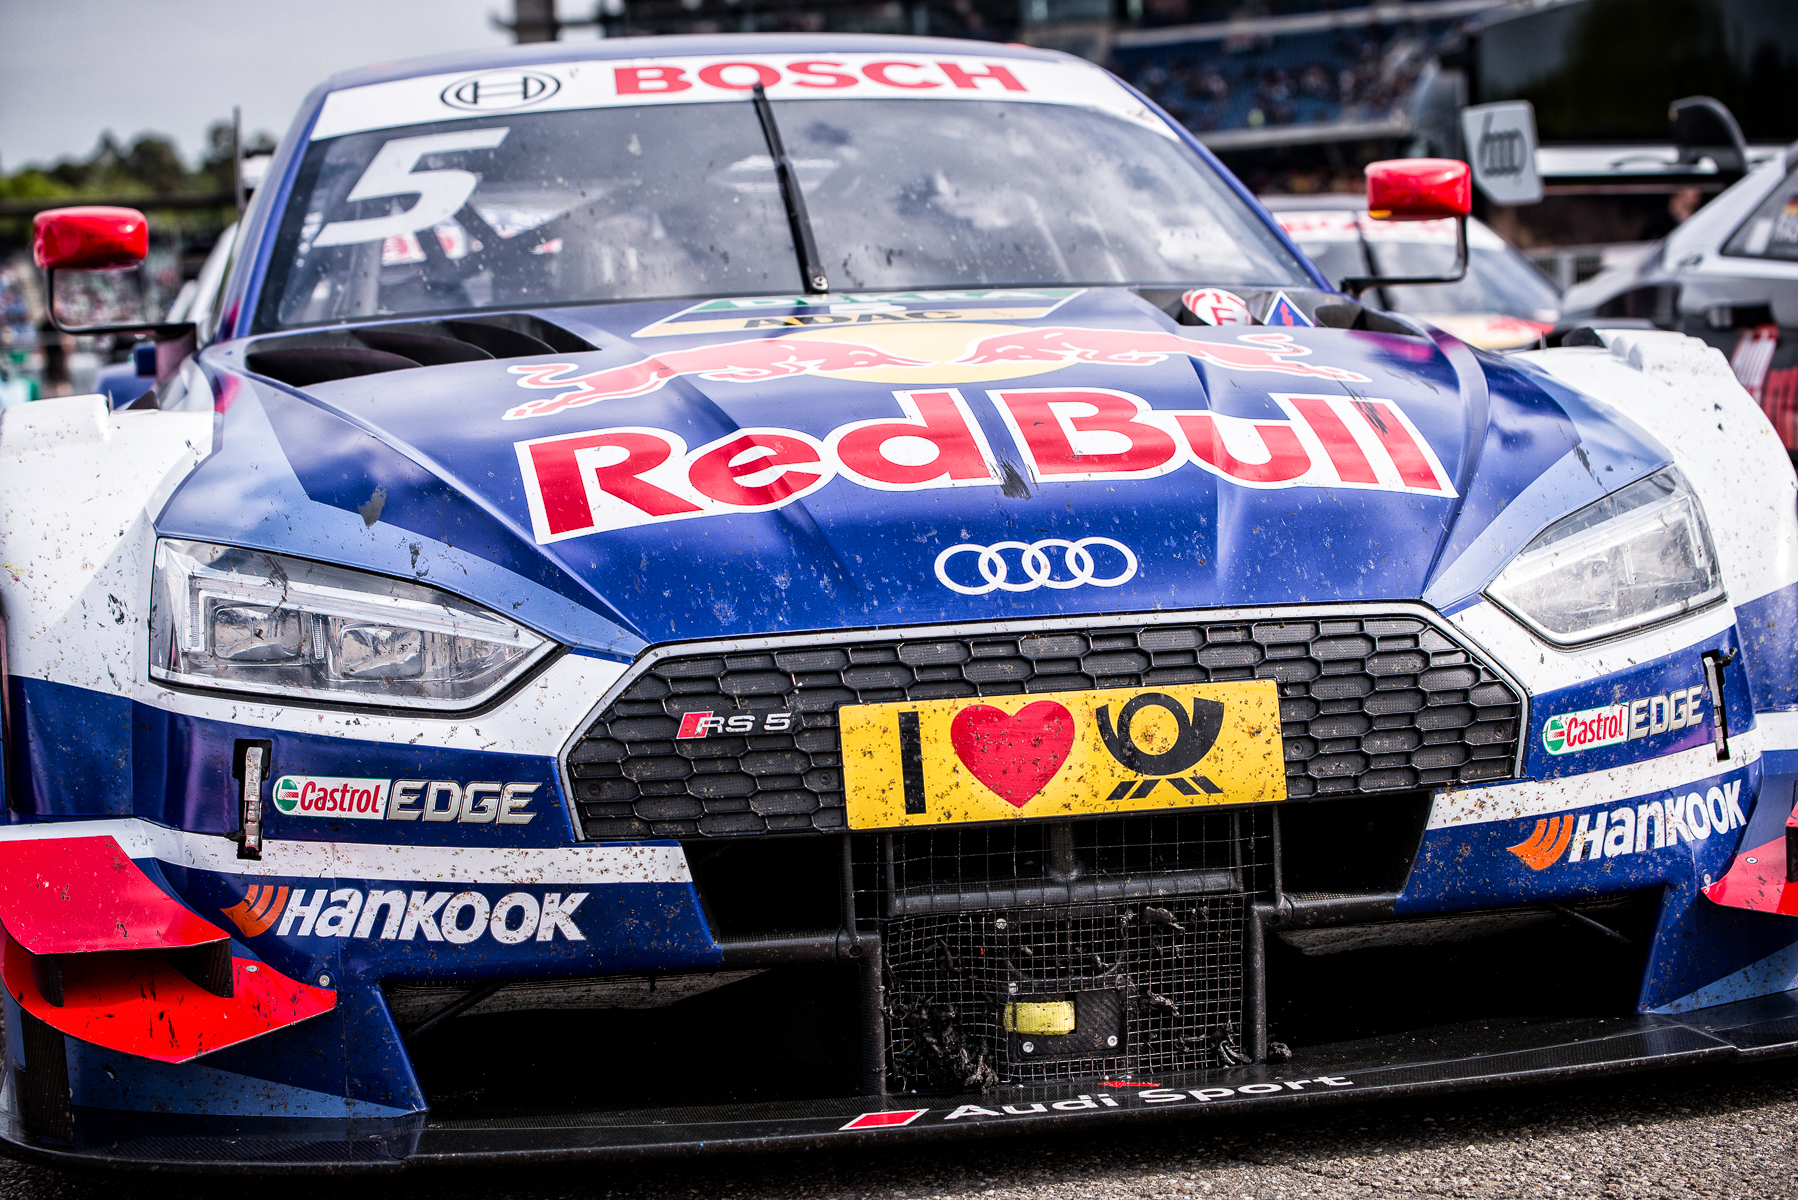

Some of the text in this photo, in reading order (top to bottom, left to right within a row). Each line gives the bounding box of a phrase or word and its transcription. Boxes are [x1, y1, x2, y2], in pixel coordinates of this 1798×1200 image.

[614, 60, 1028, 97] BOSCH
[312, 126, 510, 248] 5
[743, 311, 963, 329] ADAC
[531, 388, 1444, 537] Red Bull
[694, 712, 792, 735] RS 5
[1566, 685, 1704, 748] Castrol EDGE
[301, 778, 542, 825] Castrol EDGE
[943, 1075, 1355, 1121] Audi Sport
